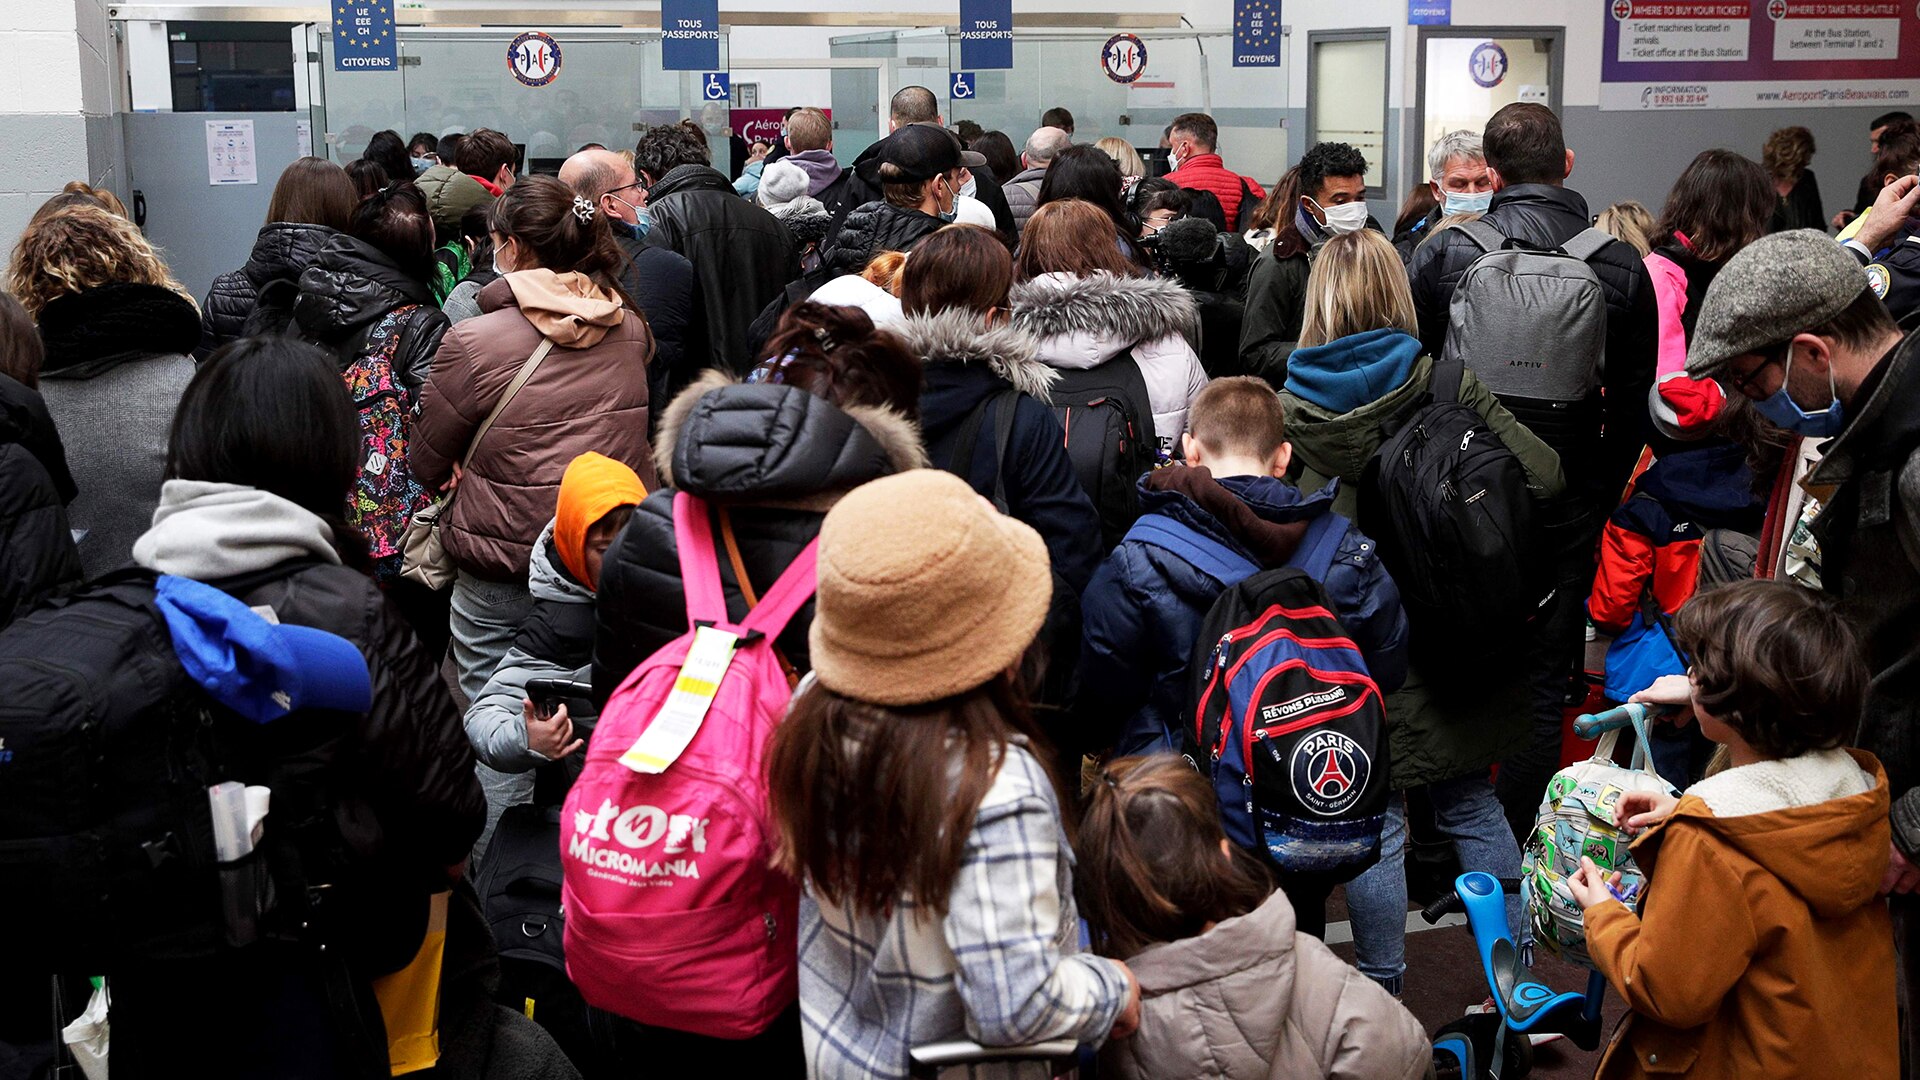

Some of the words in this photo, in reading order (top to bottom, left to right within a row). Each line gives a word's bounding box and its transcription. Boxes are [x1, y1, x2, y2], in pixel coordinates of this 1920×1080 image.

[357, 8, 369, 16] UE
[1633, 5, 1662, 15] WHERE
[1664, 5, 1675, 15] TO
[1676, 5, 1692, 15] BUY
[1692, 5, 1715, 15] YOUR
[1716, 5, 1740, 15] TICKET
[1788, 5, 1814, 15] WHERE
[1816, 5, 1828, 14] TO
[1828, 5, 1846, 14] TAKE
[1847, 5, 1861, 14] THE
[1862, 4, 1893, 14] SHUTTLE
[355, 17, 372, 26] EEE
[677, 19, 702, 29] TOUS
[974, 20, 998, 29] TOUS
[1251, 20, 1264, 28] EEE
[357, 27, 370, 35] CH
[1251, 28, 1262, 36] CH
[1633, 23, 1656, 32] Ticket
[1657, 23, 1693, 32] machines
[1694, 23, 1721, 32] located
[1723, 23, 1731, 32] in
[661, 30, 719, 39] PASSEPORTS
[960, 30, 1013, 39] PASSEPORTS
[1804, 29, 1813, 37] At
[1814, 29, 1826, 37] the
[1827, 29, 1842, 37] Bus
[1790, 40, 1822, 49] between
[1824, 40, 1855, 49] Terminal
[1864, 40, 1878, 48] and
[1632, 48, 1654, 57] Ticket
[1656, 48, 1676, 57] office
[1678, 48, 1685, 57] at
[1687, 48, 1698, 57] the
[1700, 48, 1715, 57] Bus
[341, 57, 391, 67] CITOYENS
[1238, 55, 1276, 63] CITOYENS
[1654, 86, 1708, 94] INFORMATION
[1509, 360, 1542, 368] APTIV
[1673, 522, 1689, 532] 4F
[1303, 734, 1354, 756] PARIS
[1305, 792, 1325, 808] SAINT
[1329, 789, 1357, 809] GERMAIN
[568, 833, 700, 879] MICROMANIA
[587, 867, 628, 884] Génération
